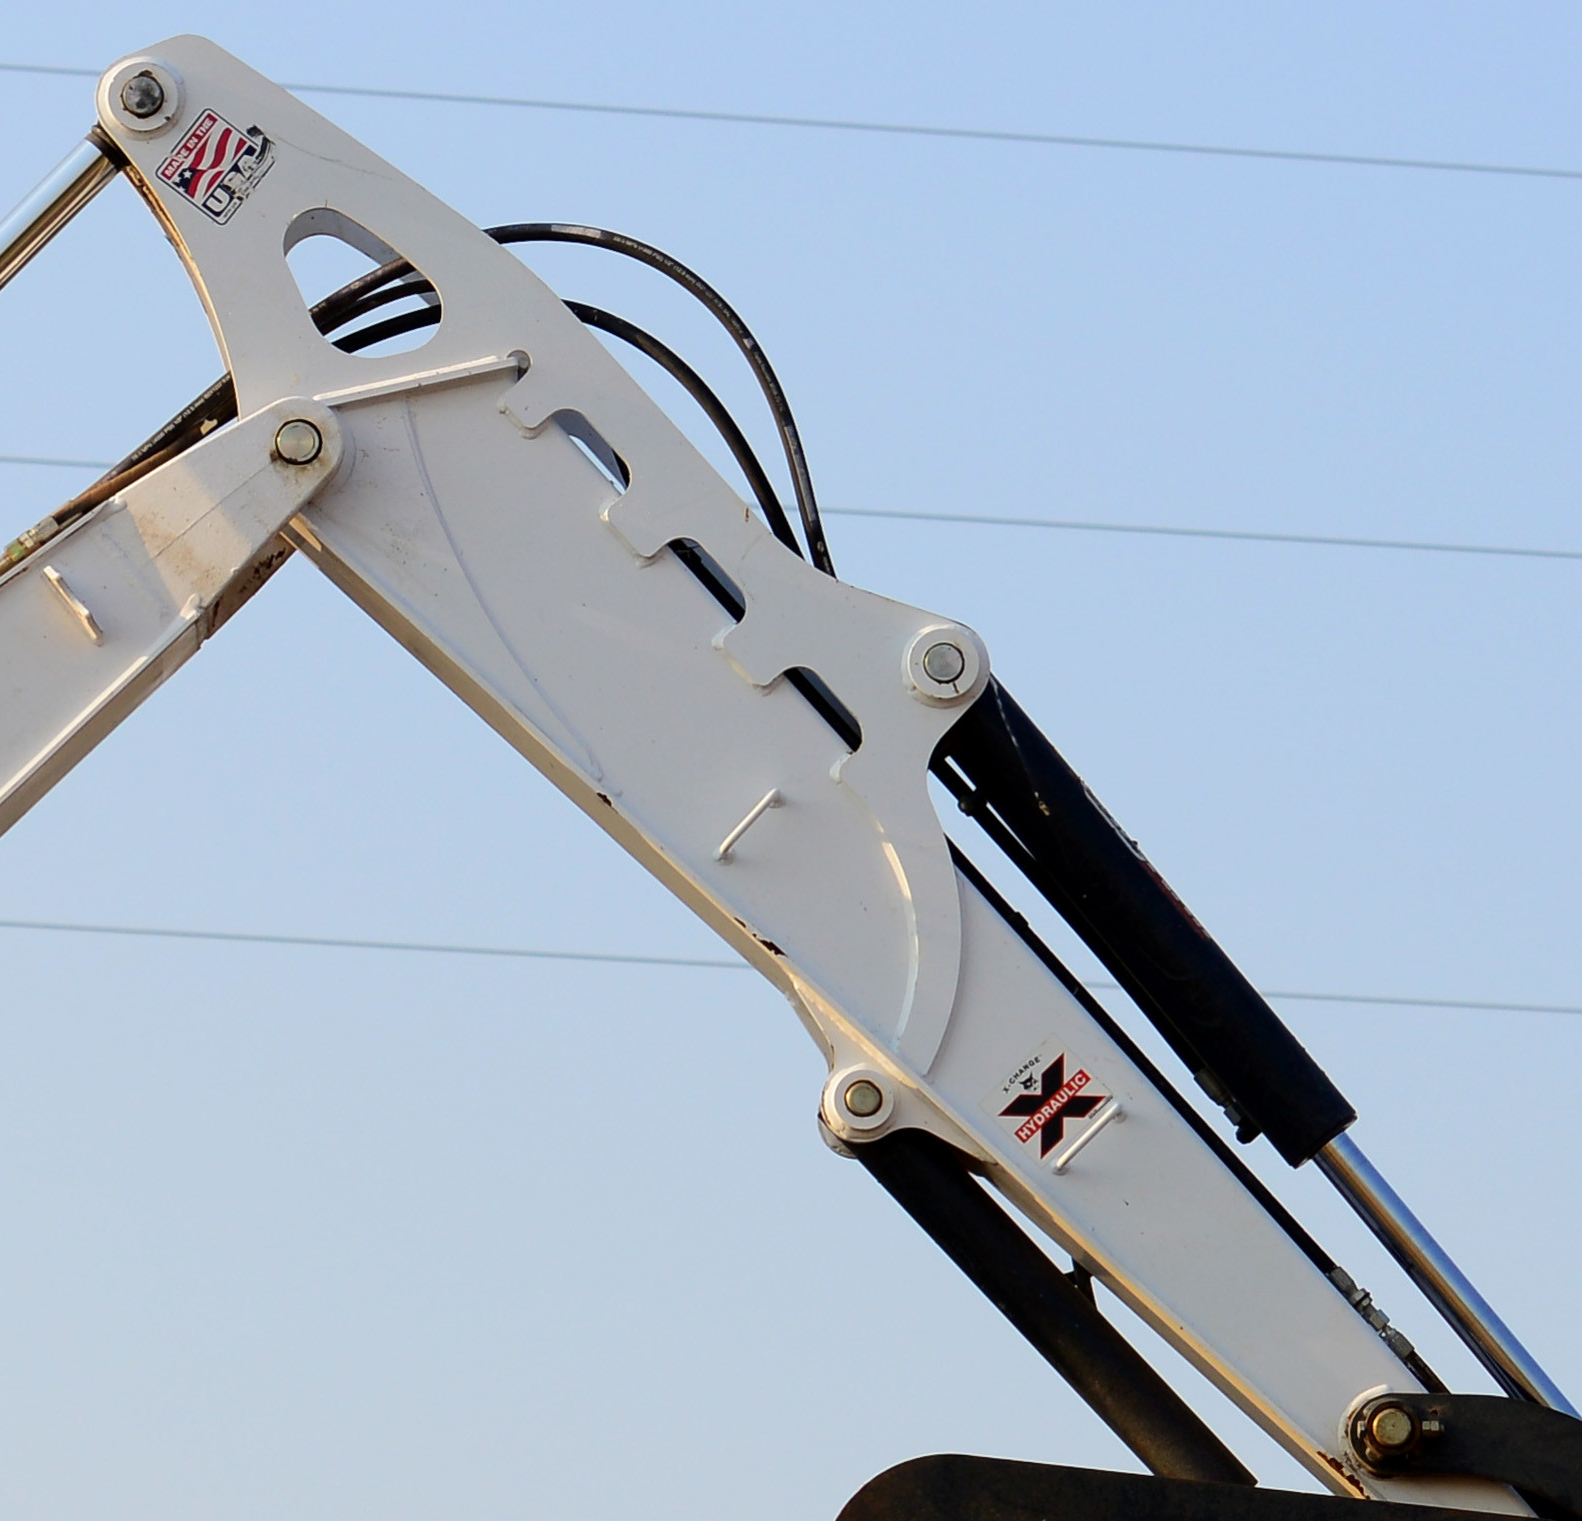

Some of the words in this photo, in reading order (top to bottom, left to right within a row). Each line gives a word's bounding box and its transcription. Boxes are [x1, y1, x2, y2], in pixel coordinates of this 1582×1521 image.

[163, 148, 189, 177] MADE
[186, 136, 199, 150] IN
[197, 117, 213, 137] THE
[1017, 1072, 1087, 1140] HYDRAULIC
